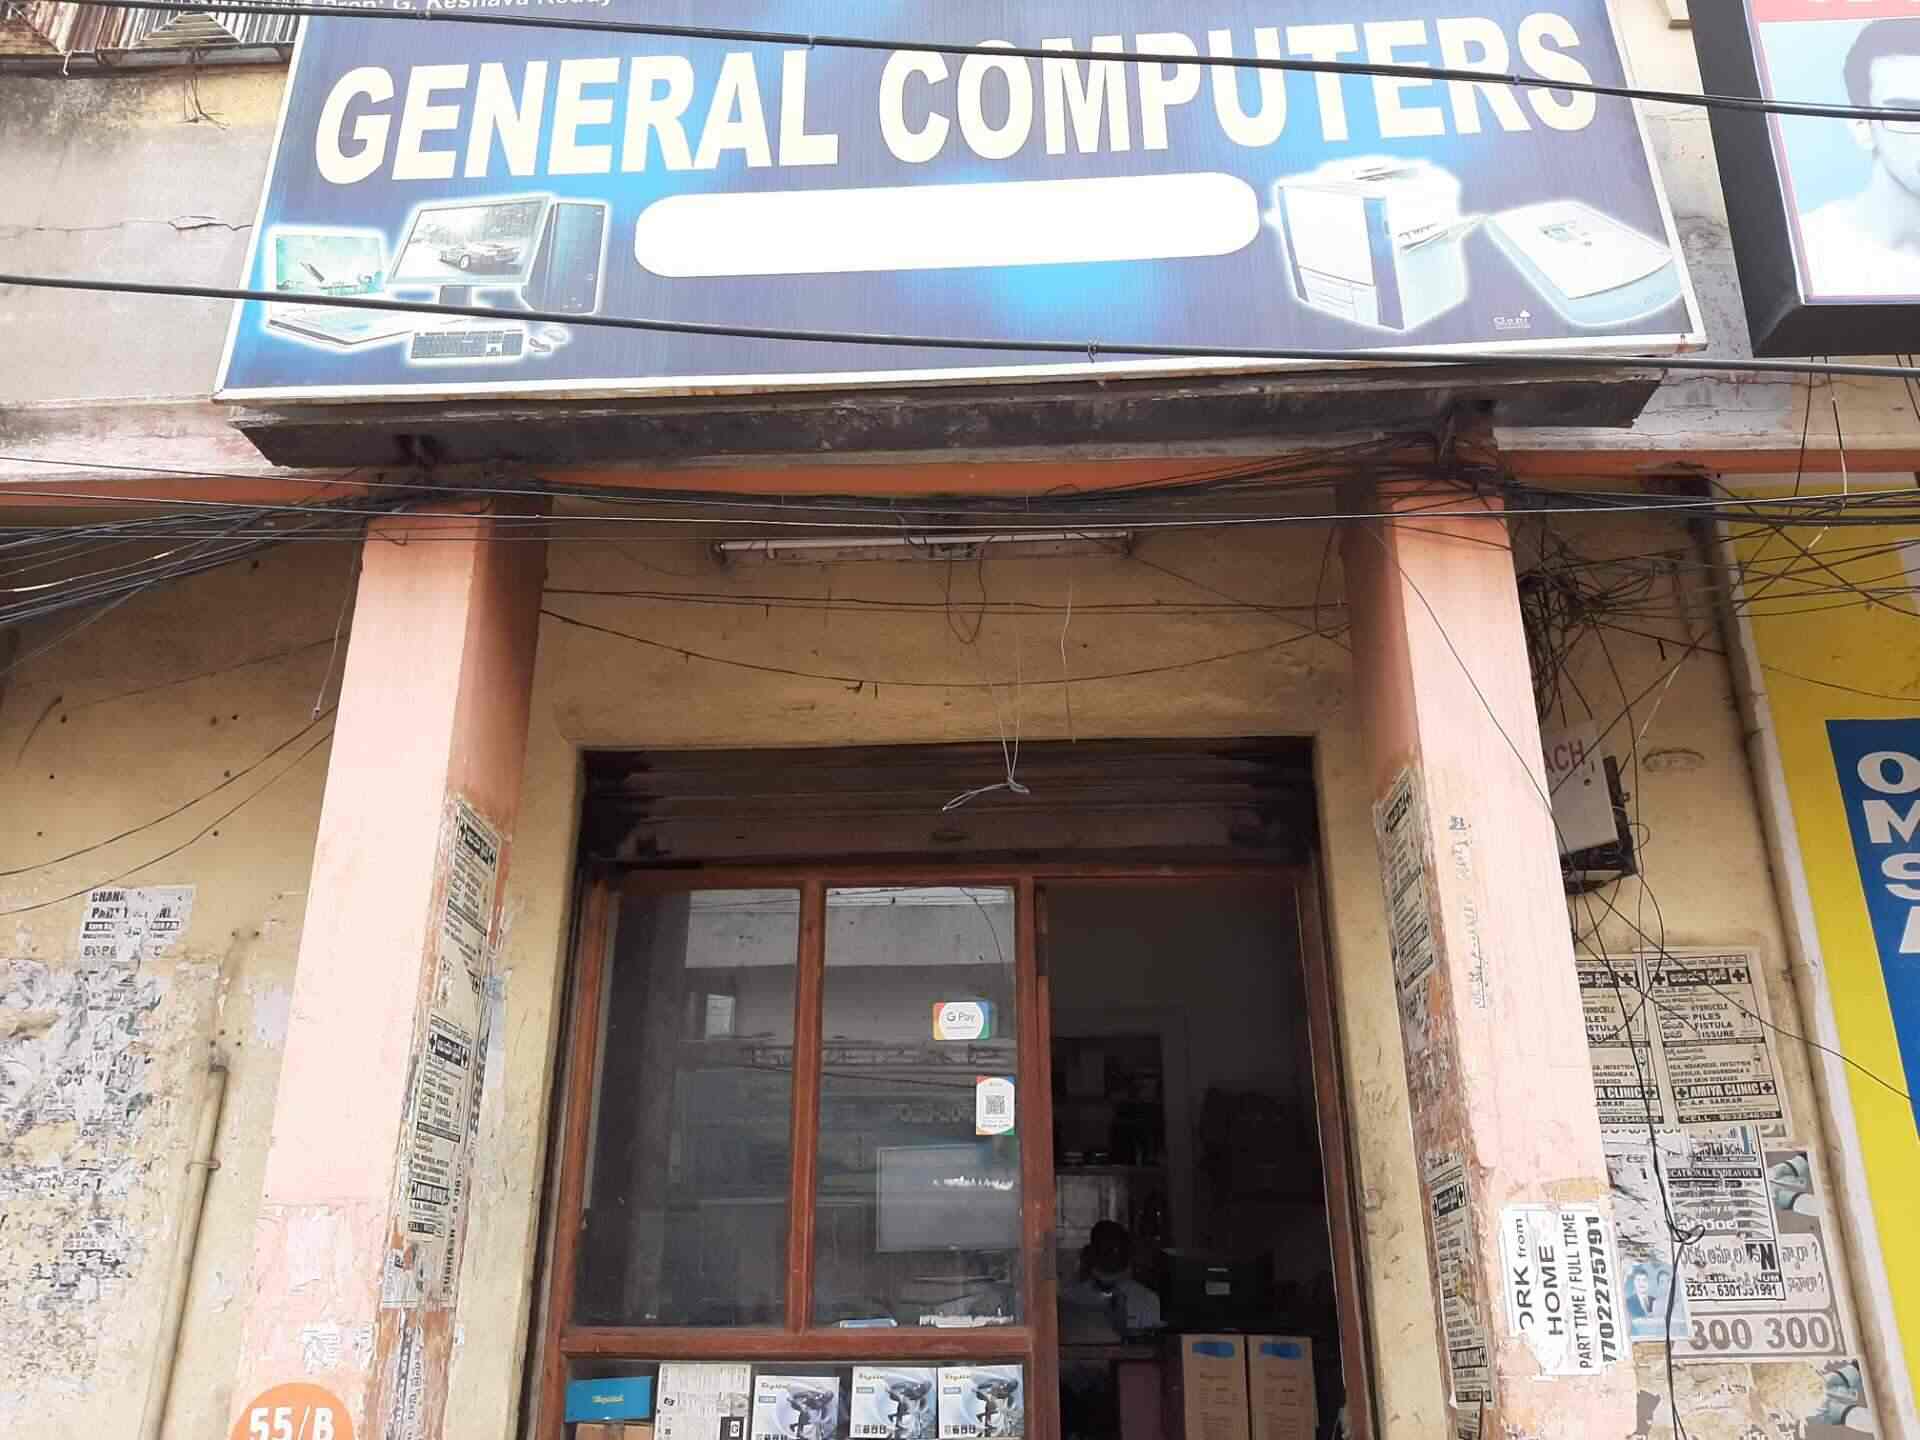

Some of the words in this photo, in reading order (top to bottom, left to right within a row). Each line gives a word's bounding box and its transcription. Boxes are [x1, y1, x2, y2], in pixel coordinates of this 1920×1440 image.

[314, 48, 838, 184] GENERAL
[878, 11, 1598, 163] COMPUTERS
[1607, 1086, 1643, 1099] CLINIC
[1689, 1083, 1724, 1098] AMIYA
[1724, 1082, 1760, 1096] CLINIC
[1561, 1213, 1578, 1247] TIME
[1568, 1250, 1583, 1282] FULL
[1538, 1245, 1564, 1336] HOME
[1573, 1295, 1588, 1329] TIME
[1764, 1316, 1830, 1349] 300
[1576, 1333, 1593, 1369] PART
[250, 1404, 335, 1440] 55/B
